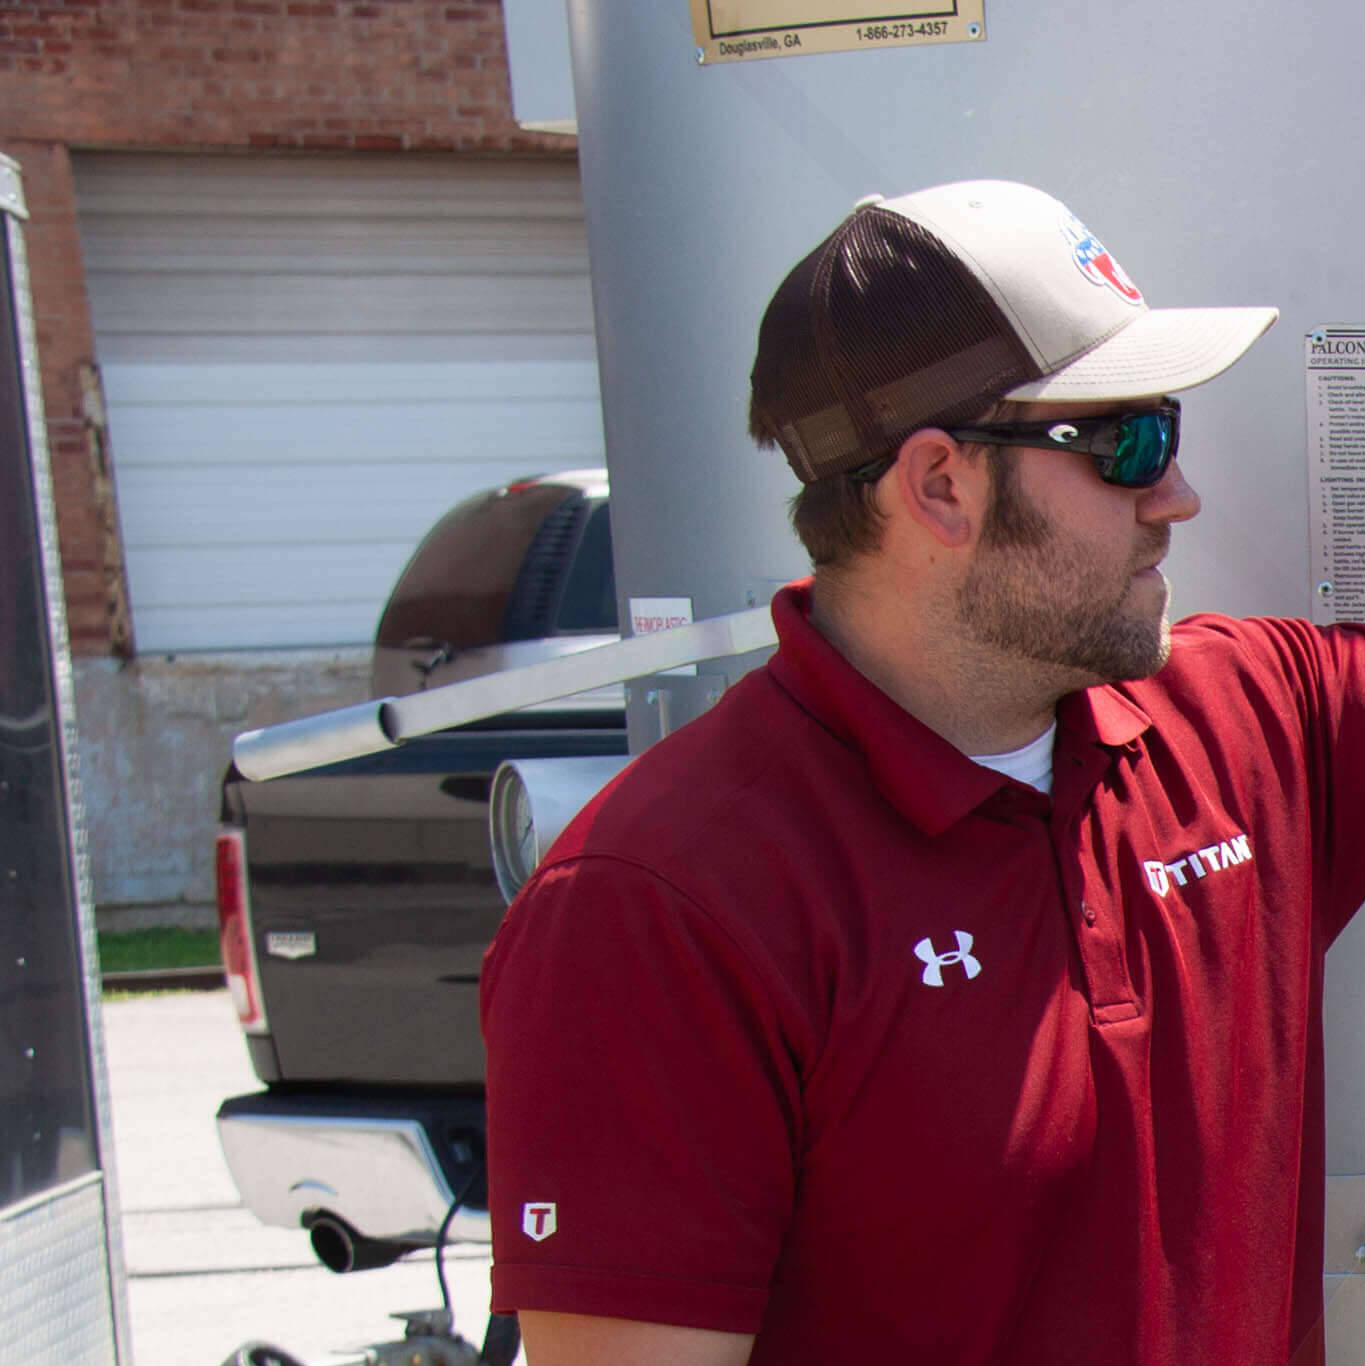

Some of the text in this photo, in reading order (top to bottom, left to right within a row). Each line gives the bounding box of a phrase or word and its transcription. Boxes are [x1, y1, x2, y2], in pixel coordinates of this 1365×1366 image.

[855, 21, 949, 41] 1-866-273-4357
[718, 34, 802, 57] Douglasville, GA
[1310, 358, 1360, 366] OPERATING
[1165, 834, 1253, 886] TITAN
